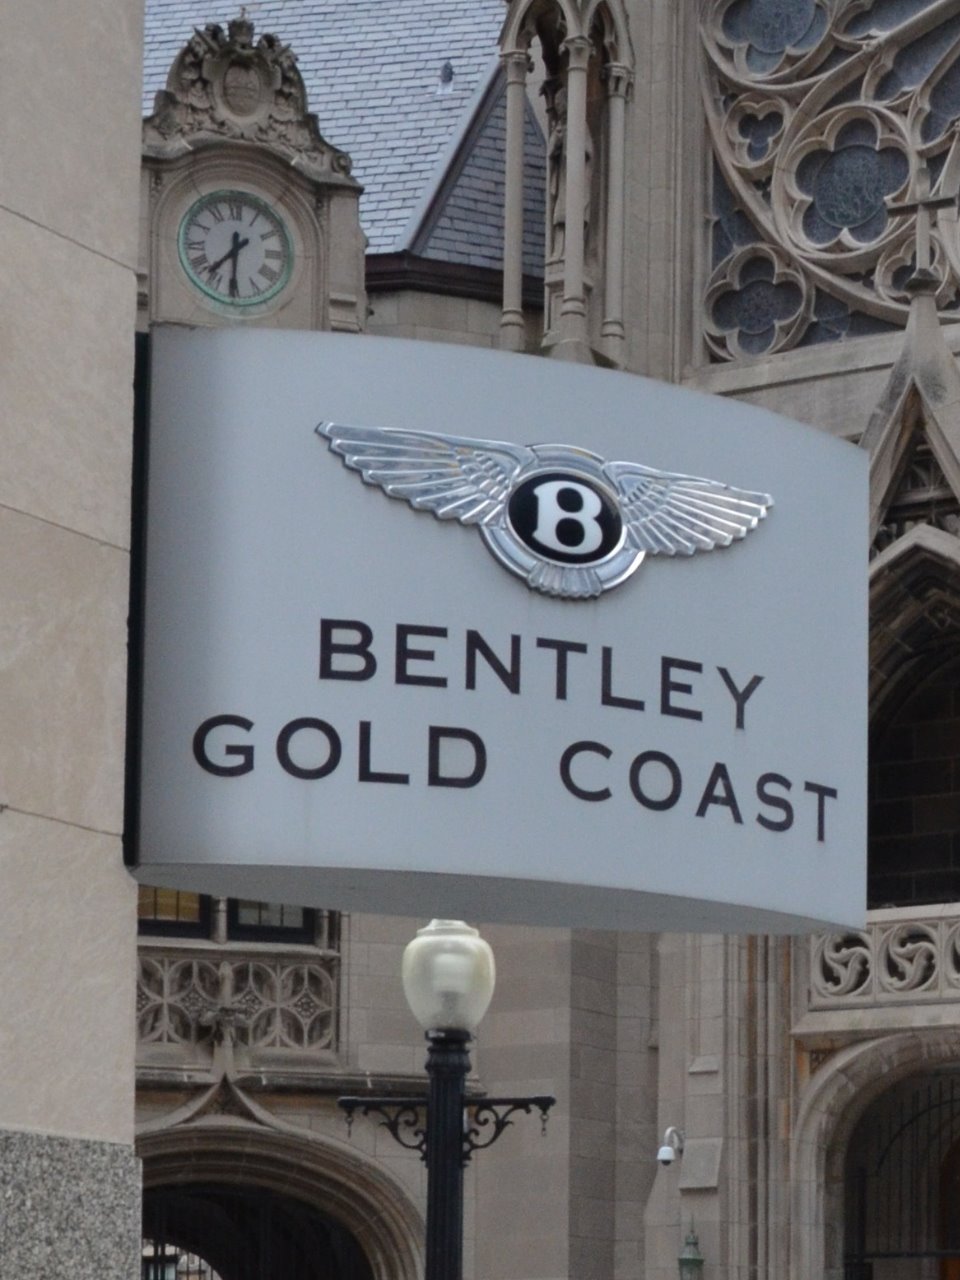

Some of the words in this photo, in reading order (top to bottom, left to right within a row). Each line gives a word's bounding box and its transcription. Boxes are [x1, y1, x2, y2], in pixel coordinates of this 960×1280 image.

[318, 618, 764, 730] BENTLEY
[191, 713, 488, 790] GOLD
[559, 740, 838, 843] COAST
